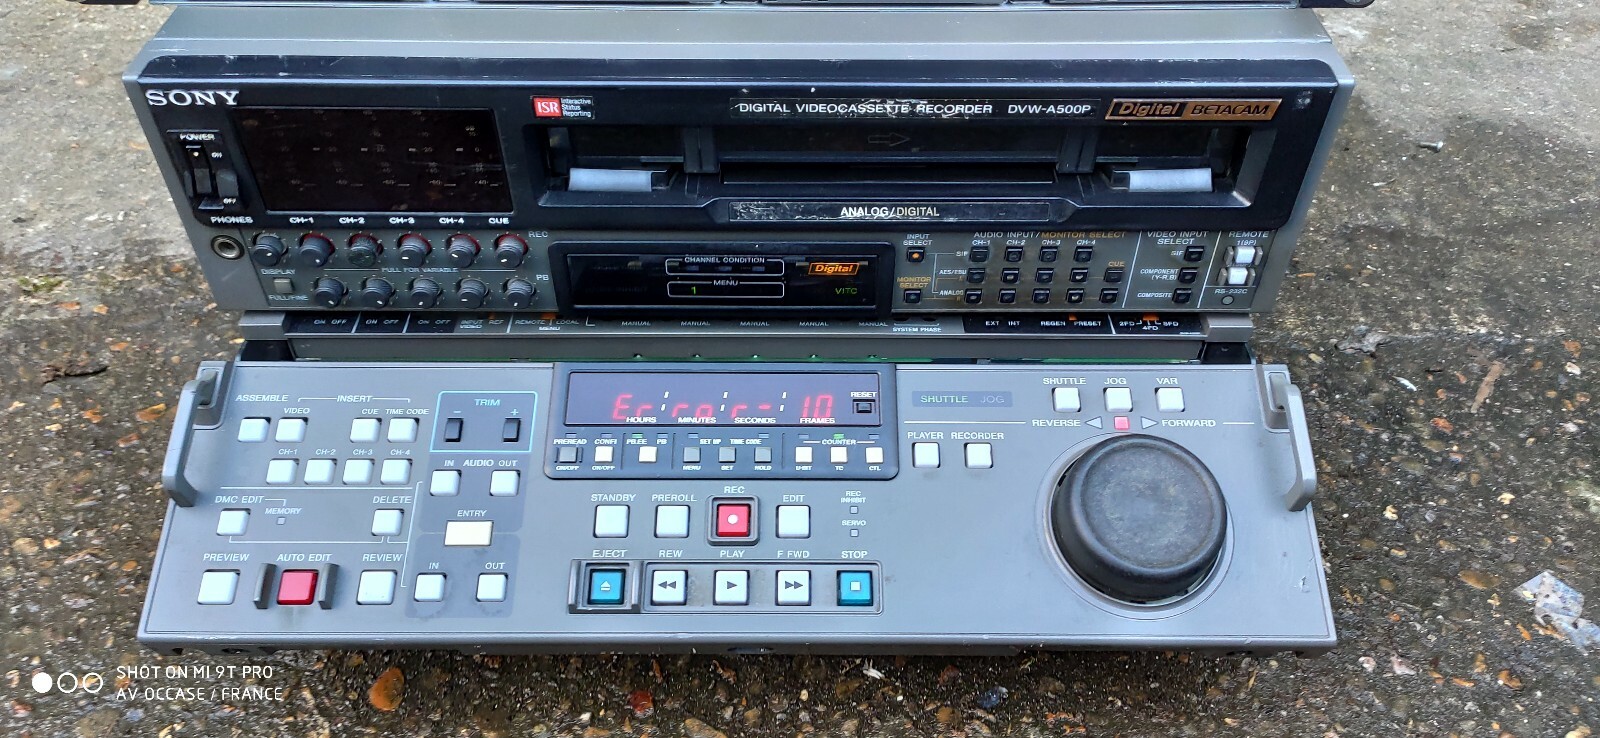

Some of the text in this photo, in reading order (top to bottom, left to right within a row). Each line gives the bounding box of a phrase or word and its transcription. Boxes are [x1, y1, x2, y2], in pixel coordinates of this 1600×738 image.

[145, 89, 240, 106] SONY
[537, 102, 559, 113] ISR
[739, 103, 1091, 114] DIGITAL VIDEOCASSETTE RECORDER DVW-A500P
[1119, 102, 1270, 117] Digital BETACAM
[180, 133, 215, 141] POWER
[840, 206, 940, 217] ANALOG/DIGITAL
[210, 216, 253, 224] PHONES
[815, 264, 853, 273] Digital
[235, 394, 289, 402] ASSEMBLE
[474, 398, 500, 406] TRIM
[950, 432, 1004, 440] RECORDER
[724, 486, 745, 494] REC
[215, 496, 264, 504] DMC EDIT
[372, 496, 412, 504] DELETE
[590, 494, 636, 502] STANDBY
[651, 494, 698, 502] PREROLL
[203, 554, 250, 562] PREVIEW
[276, 554, 332, 562] AUTO EDIT
[362, 554, 403, 562] REVIEW
[592, 550, 628, 558] EJECT
[658, 550, 684, 558] REW
[720, 550, 746, 558] PLAY
[777, 550, 810, 558] F FWD
[841, 550, 868, 558] STOP
[428, 562, 440, 570] IN
[485, 562, 506, 570] OUT
